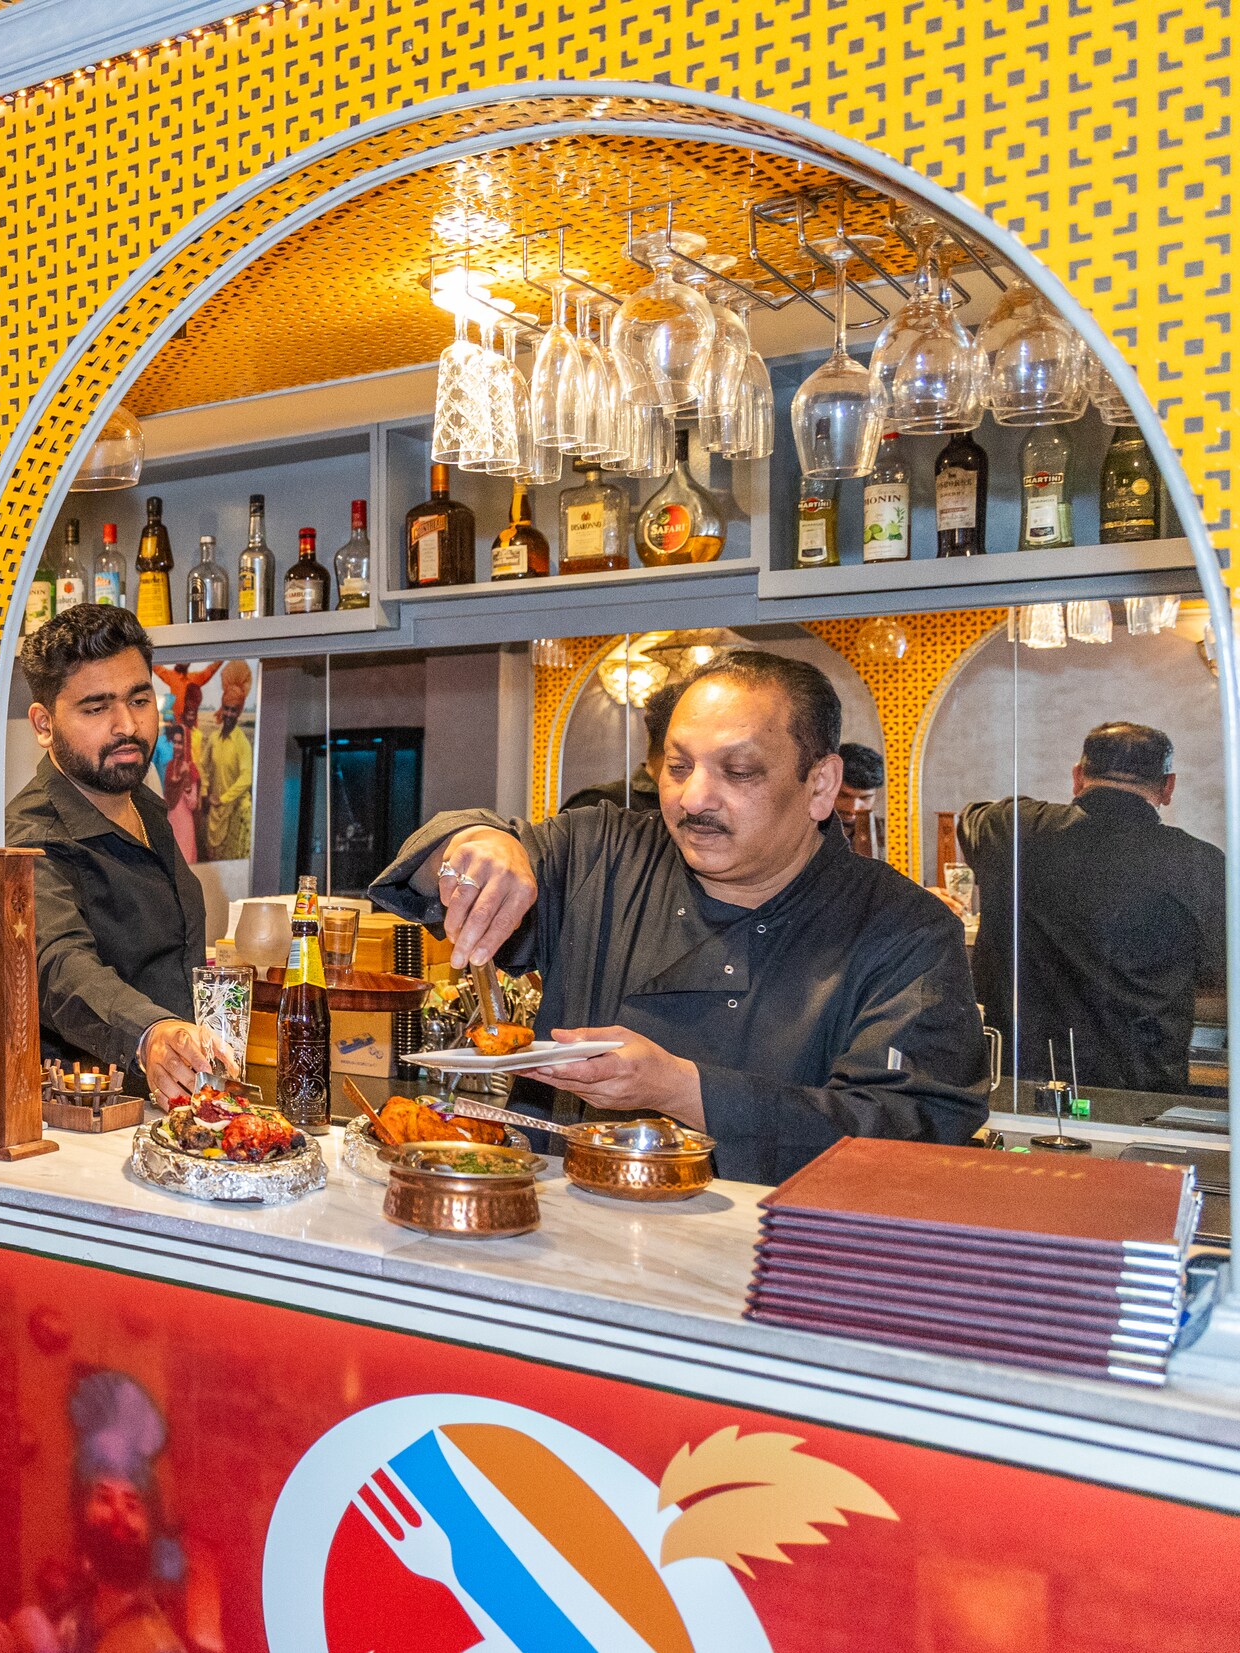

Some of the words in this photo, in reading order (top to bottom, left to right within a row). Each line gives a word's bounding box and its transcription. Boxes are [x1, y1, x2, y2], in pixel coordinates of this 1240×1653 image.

[1025, 474, 1061, 485] MARTINI
[798, 500, 830, 510] MARTINI
[570, 521, 602, 532] DISARONNO
[650, 523, 686, 535] SAFARI
